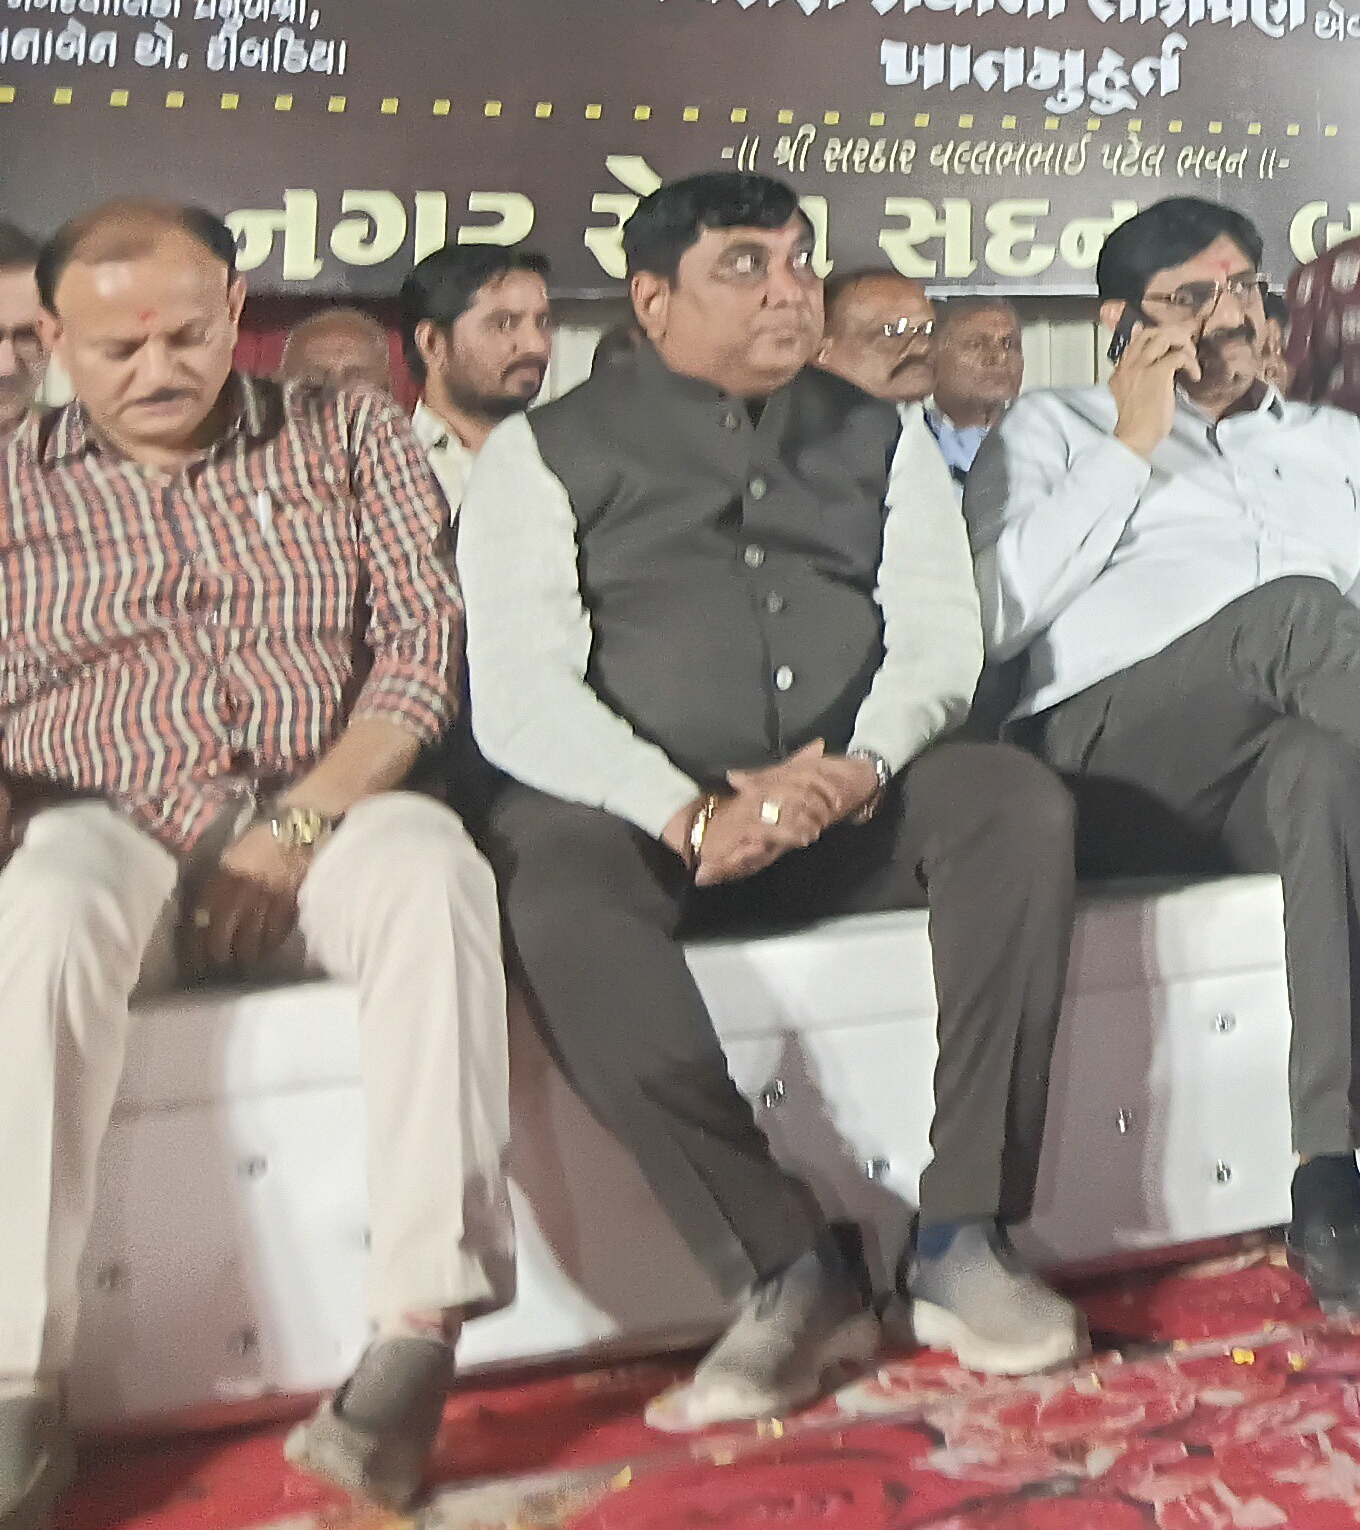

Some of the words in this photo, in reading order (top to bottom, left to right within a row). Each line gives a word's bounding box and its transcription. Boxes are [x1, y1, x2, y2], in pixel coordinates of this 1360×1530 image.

[773, 122, 817, 173] શ્રી
[823, 136, 917, 176] સરદાર
[1101, 130, 1166, 179] પટેલ
[1176, 142, 1249, 181] ભવન
